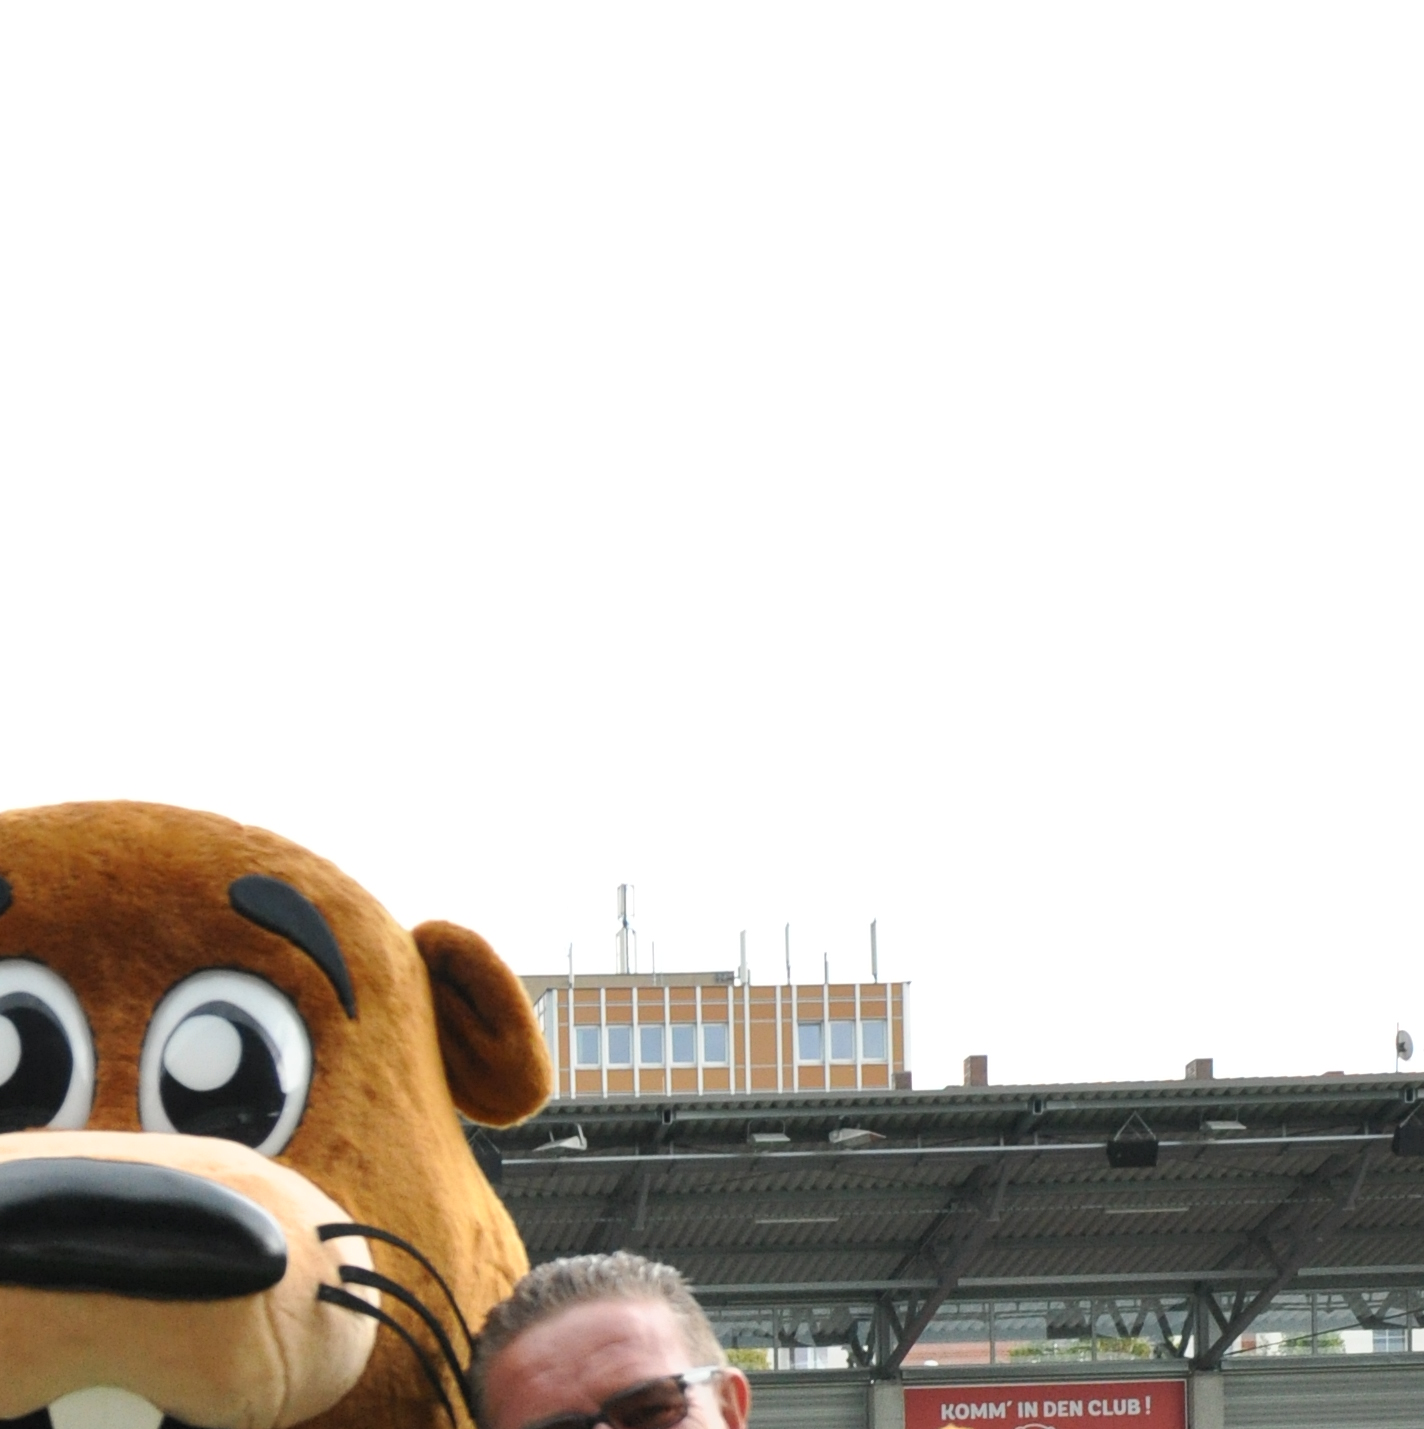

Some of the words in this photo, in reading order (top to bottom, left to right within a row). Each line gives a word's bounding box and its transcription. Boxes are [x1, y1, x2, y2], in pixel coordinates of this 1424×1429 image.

[1017, 1401, 1038, 1418] IN
[1042, 1400, 1084, 1418] DEN
[1087, 1398, 1142, 1417] CLUB
[1144, 1395, 1152, 1415] !
